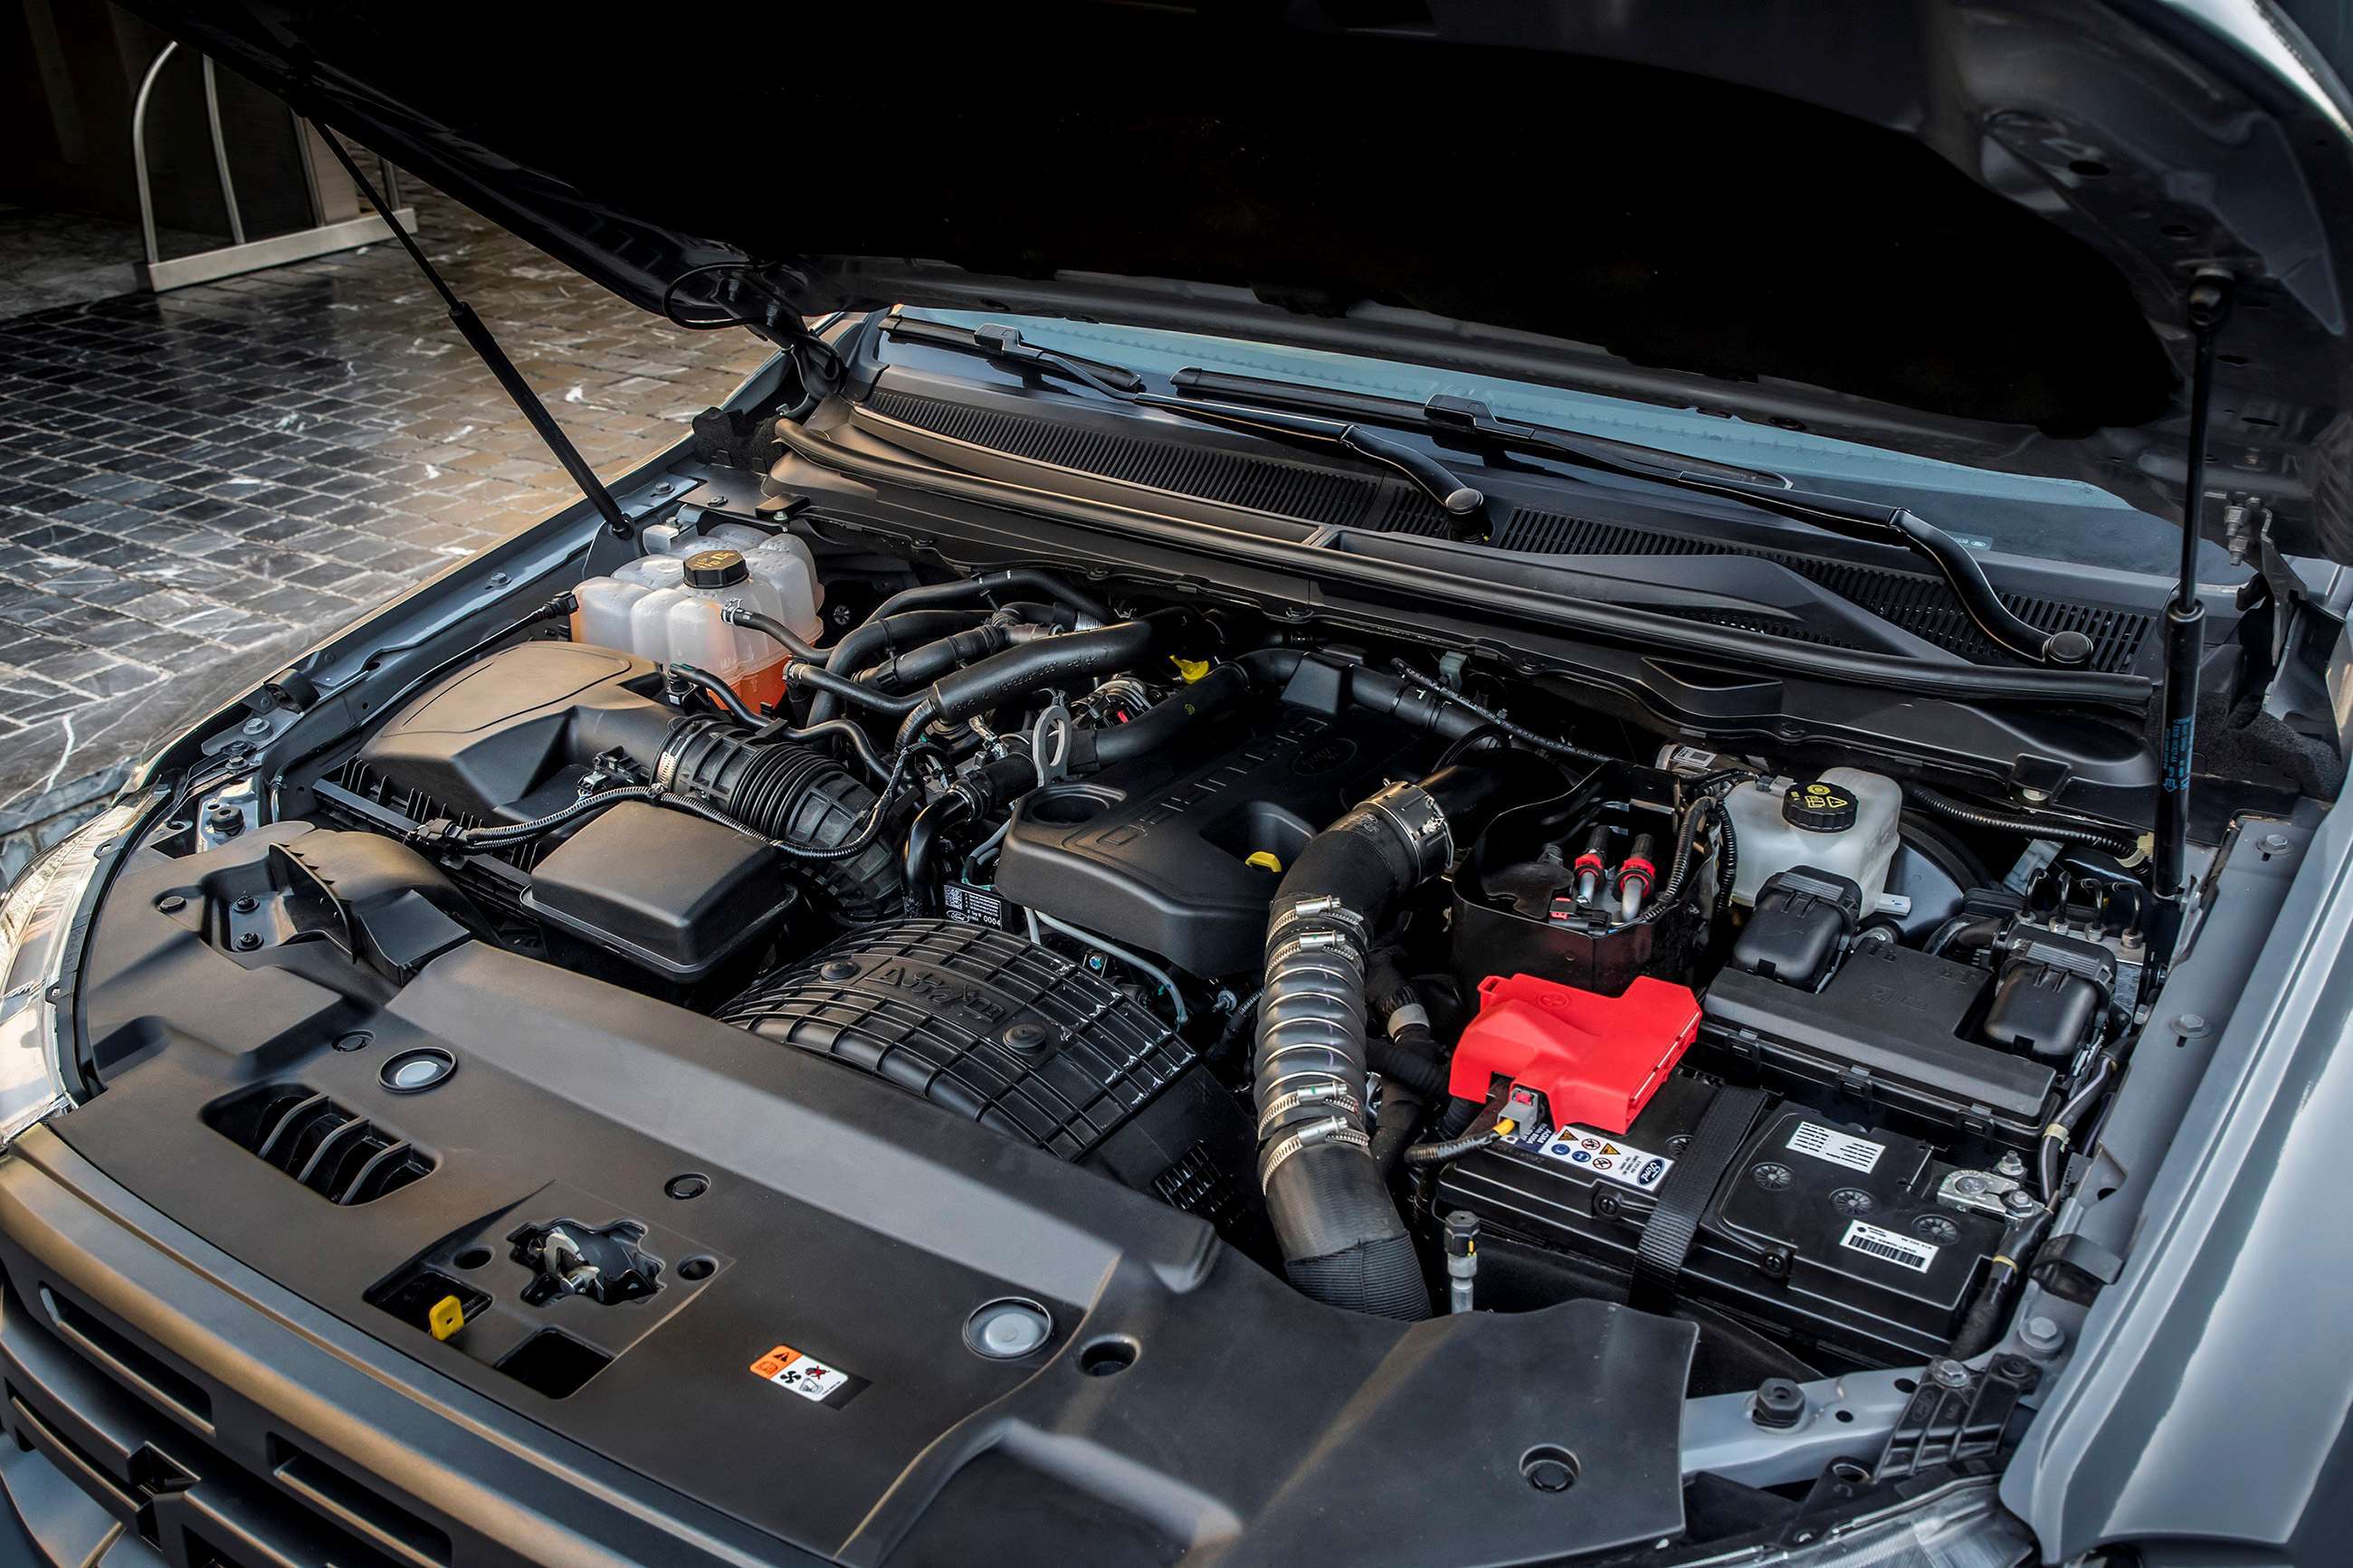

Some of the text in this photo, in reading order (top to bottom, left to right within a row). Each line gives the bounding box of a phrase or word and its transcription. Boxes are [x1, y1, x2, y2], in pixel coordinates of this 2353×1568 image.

[948, 911, 967, 922] Ford
[983, 915, 1001, 927] 0004
[1639, 1161, 1662, 1183] Ford
